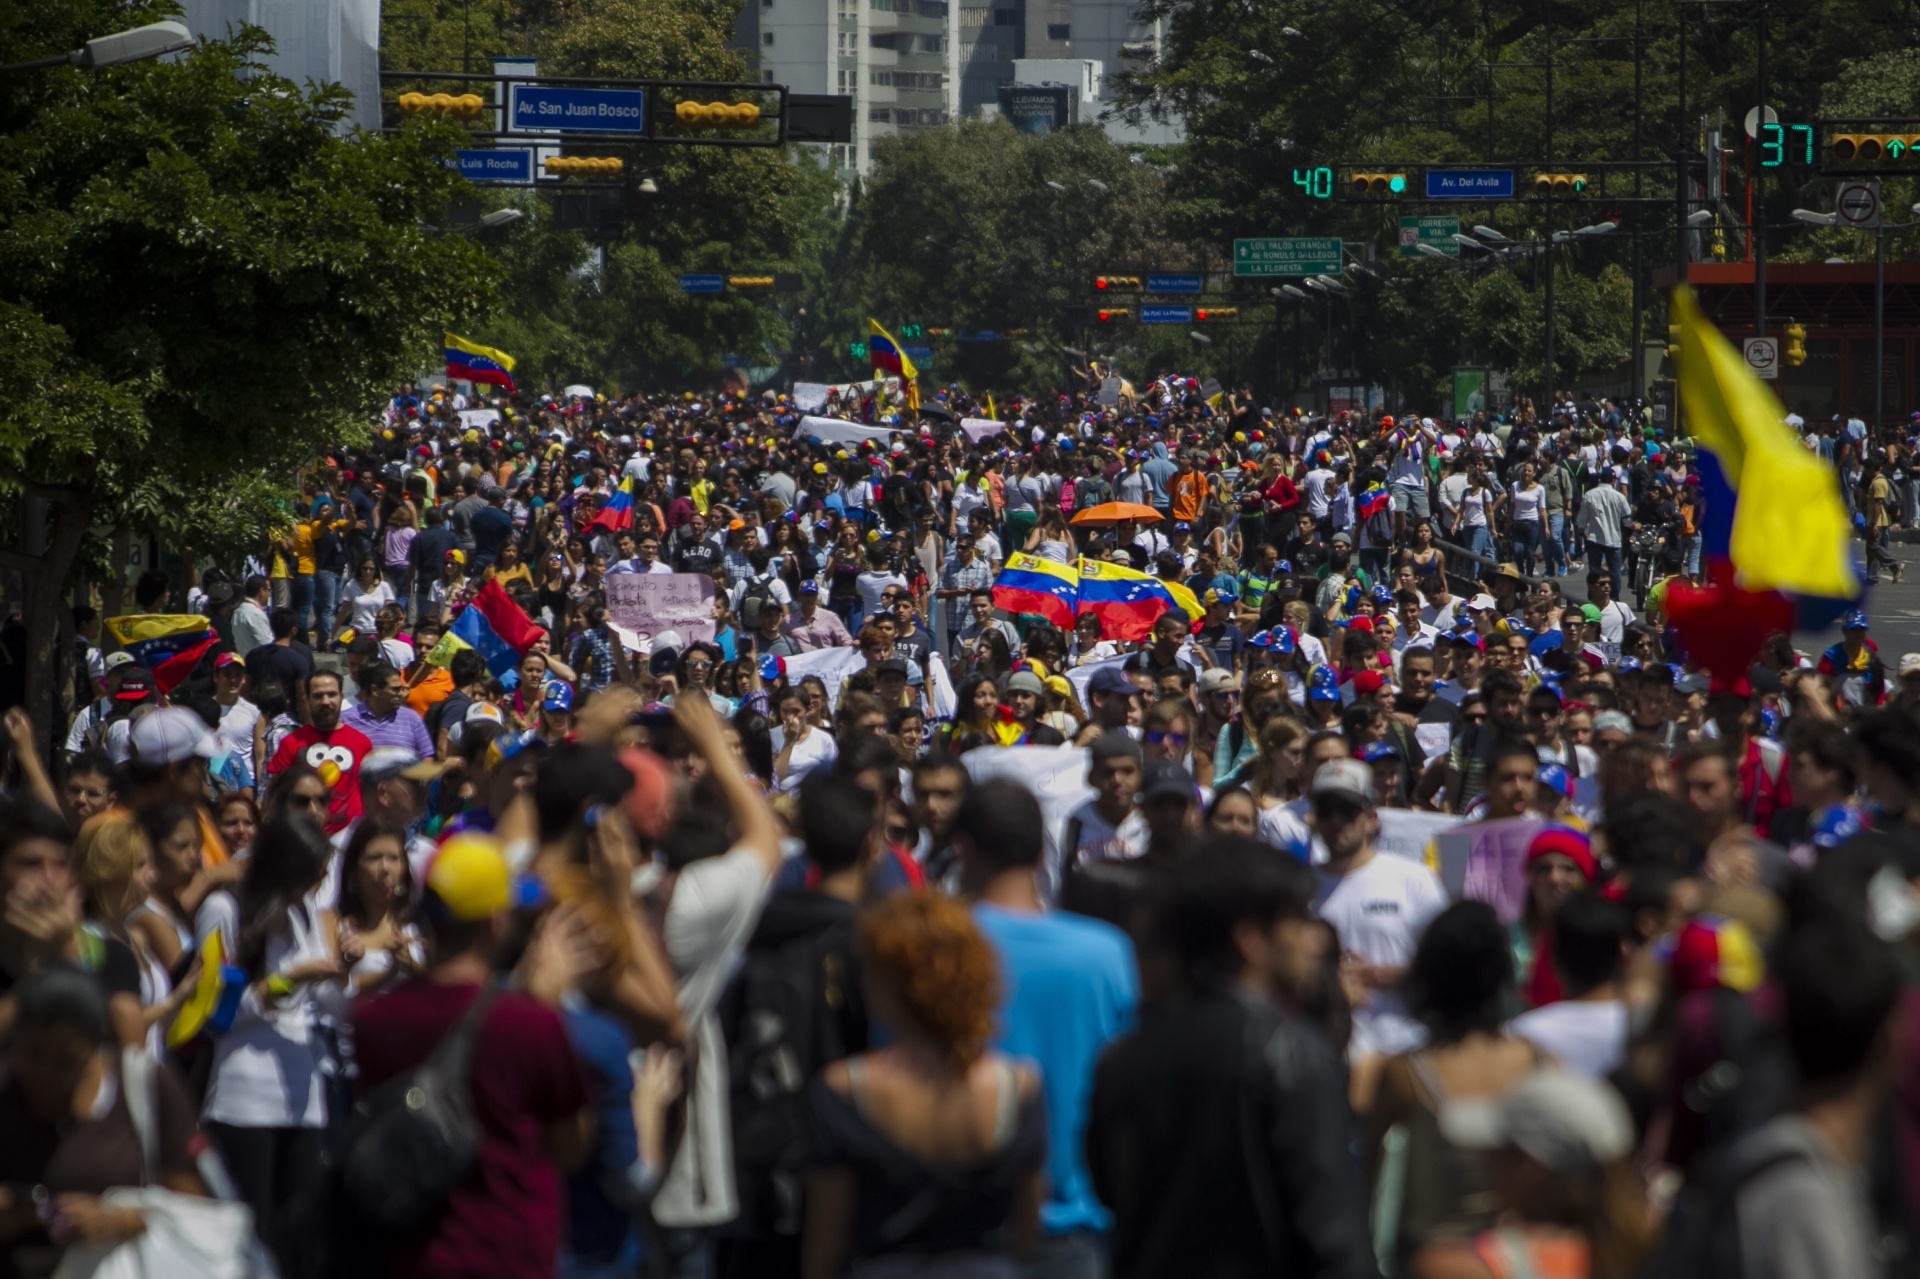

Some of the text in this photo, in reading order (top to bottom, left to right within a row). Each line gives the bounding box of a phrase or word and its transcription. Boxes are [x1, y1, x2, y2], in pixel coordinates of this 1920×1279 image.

[518, 101, 639, 117] Av. San Juan Bosco
[1761, 124, 1813, 166] 37
[461, 159, 483, 169] Luis
[487, 159, 518, 169] Roche
[1293, 167, 1332, 198] 40
[1441, 177, 1456, 187] Av.
[1458, 177, 1474, 186] Del
[1418, 218, 1458, 227] CORREDOR
[1429, 228, 1447, 237] VIAL
[1250, 241, 1332, 250] LOS PALOS GRANDES
[1298, 251, 1337, 259] GALLEGOS
[1251, 264, 1302, 272] LA FLORESTA
